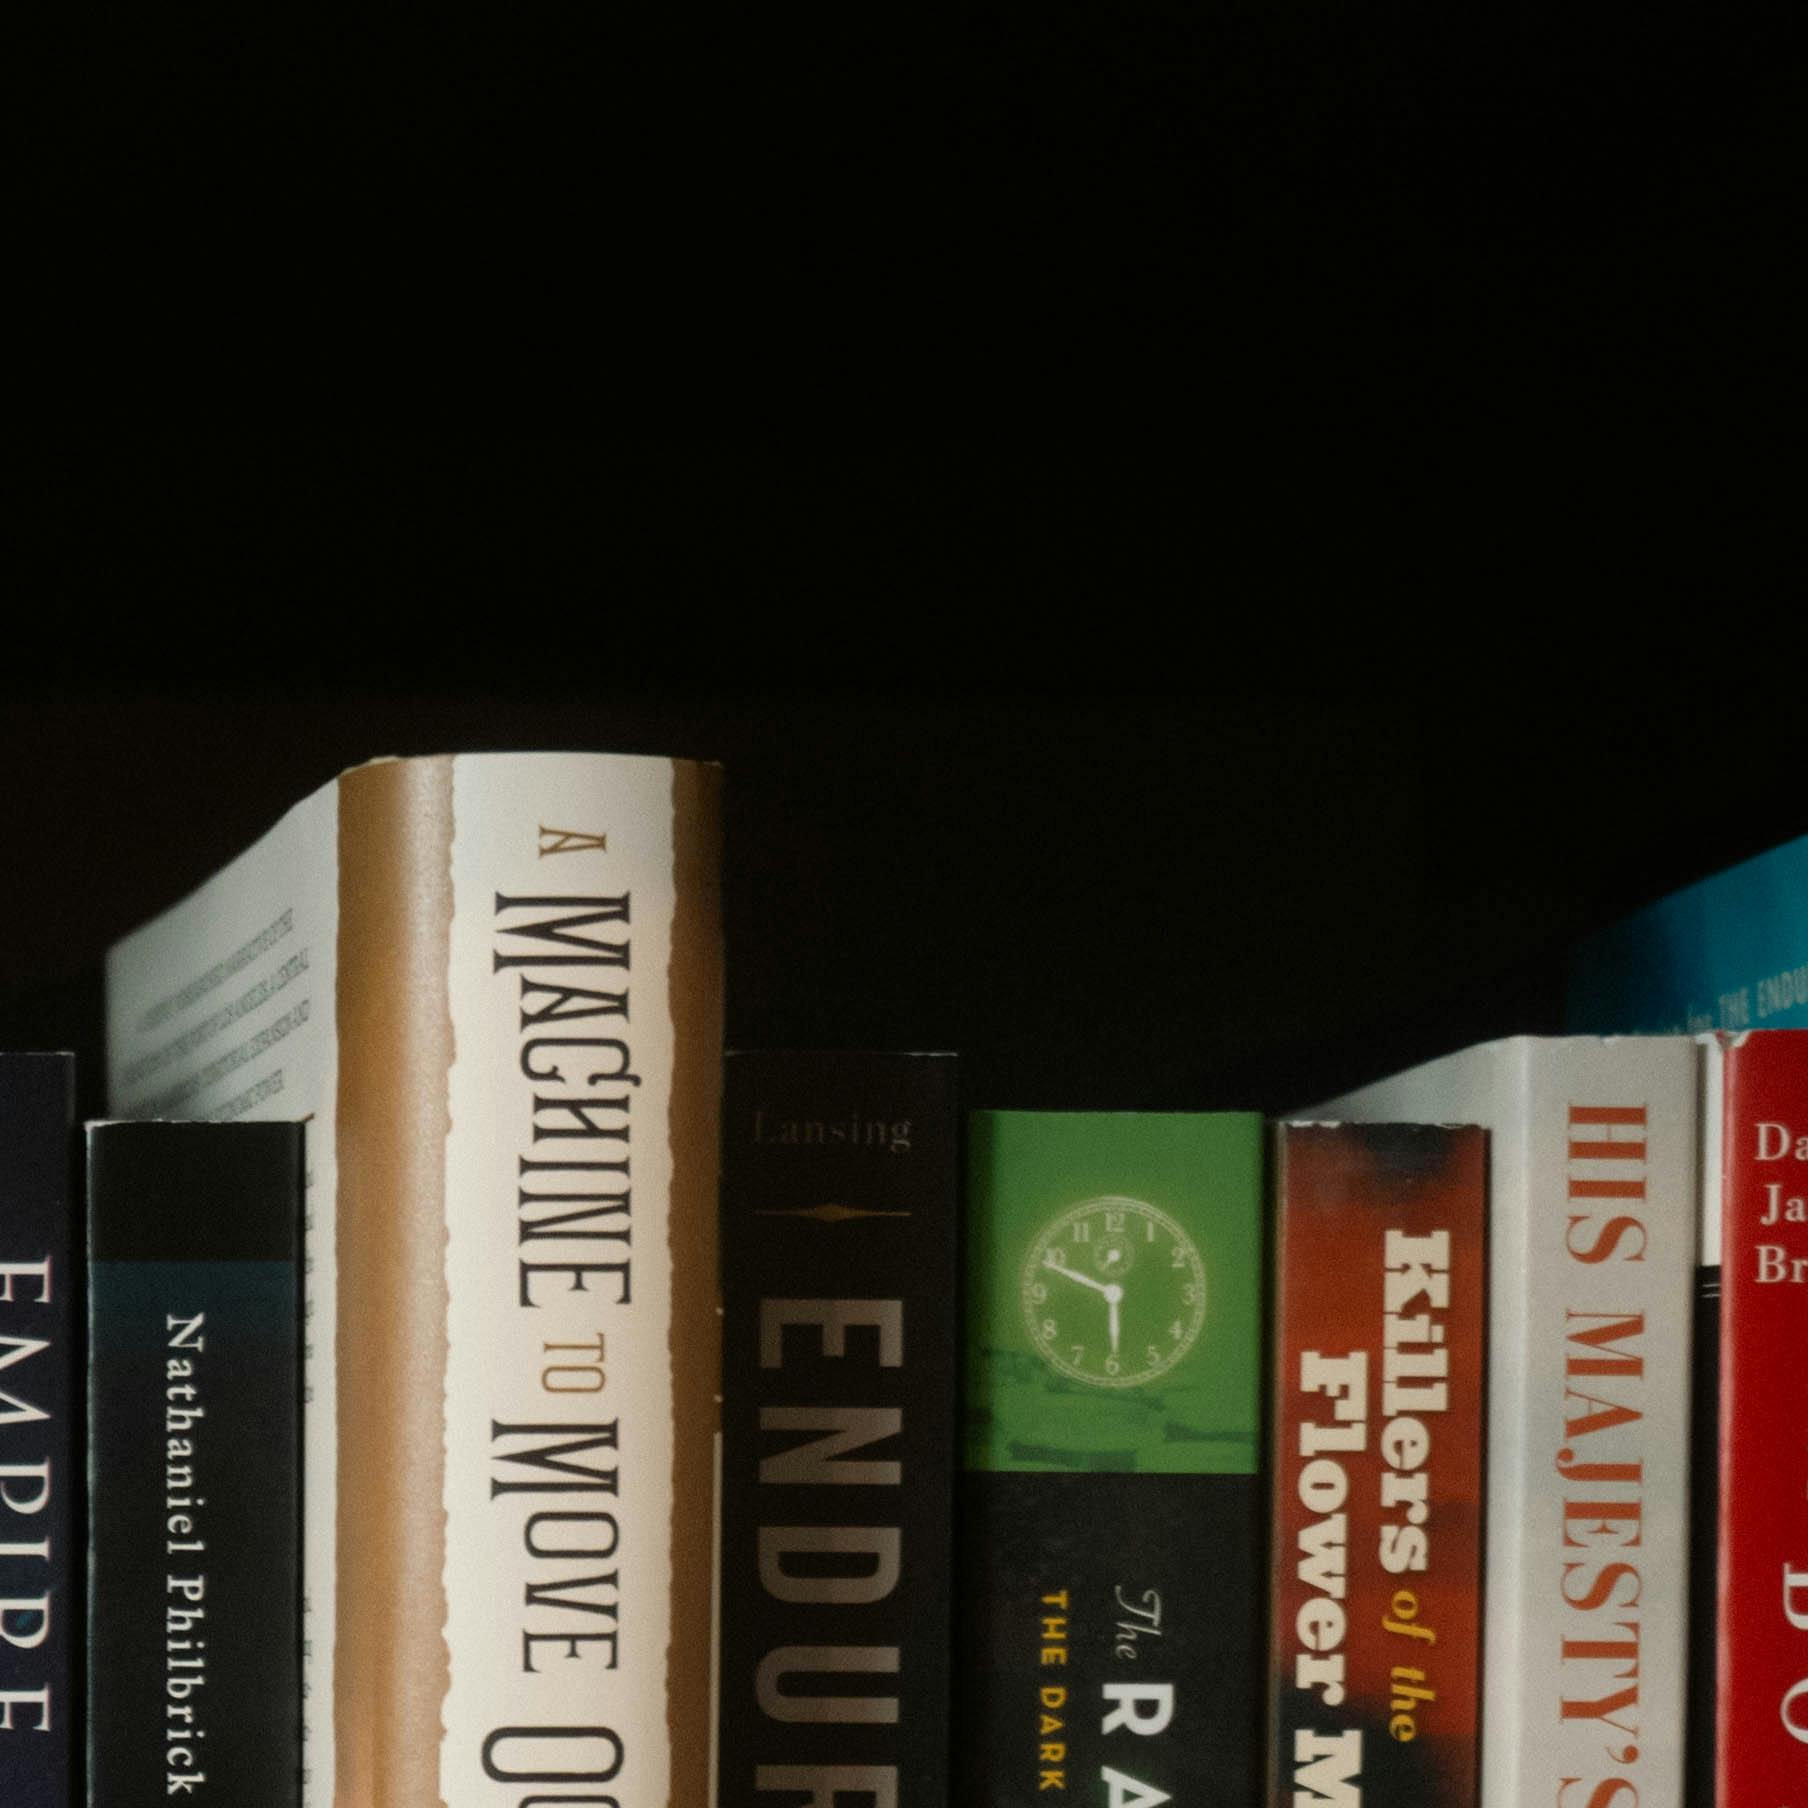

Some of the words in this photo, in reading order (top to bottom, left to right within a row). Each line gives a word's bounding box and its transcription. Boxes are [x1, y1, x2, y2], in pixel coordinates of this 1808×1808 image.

[539, 826, 607, 859] A
[492, 890, 642, 1309] MACHINE
[1565, 1102, 1649, 1265] HIS
[541, 1332, 606, 1394] TO
[1378, 1227, 1451, 1575] Killers
[164, 1312, 207, 1555] Nathaniel
[490, 1418, 621, 1674] MOVE
[1295, 1349, 1369, 1707] Flower
[164, 1573, 208, 1796] Philbrick
[1039, 1588, 1070, 1667] THE
[1114, 1584, 1163, 1661] The
[1381, 1588, 1437, 1646] of
[1038, 1685, 1069, 1793] DARK
[1388, 1664, 1438, 1744] the
